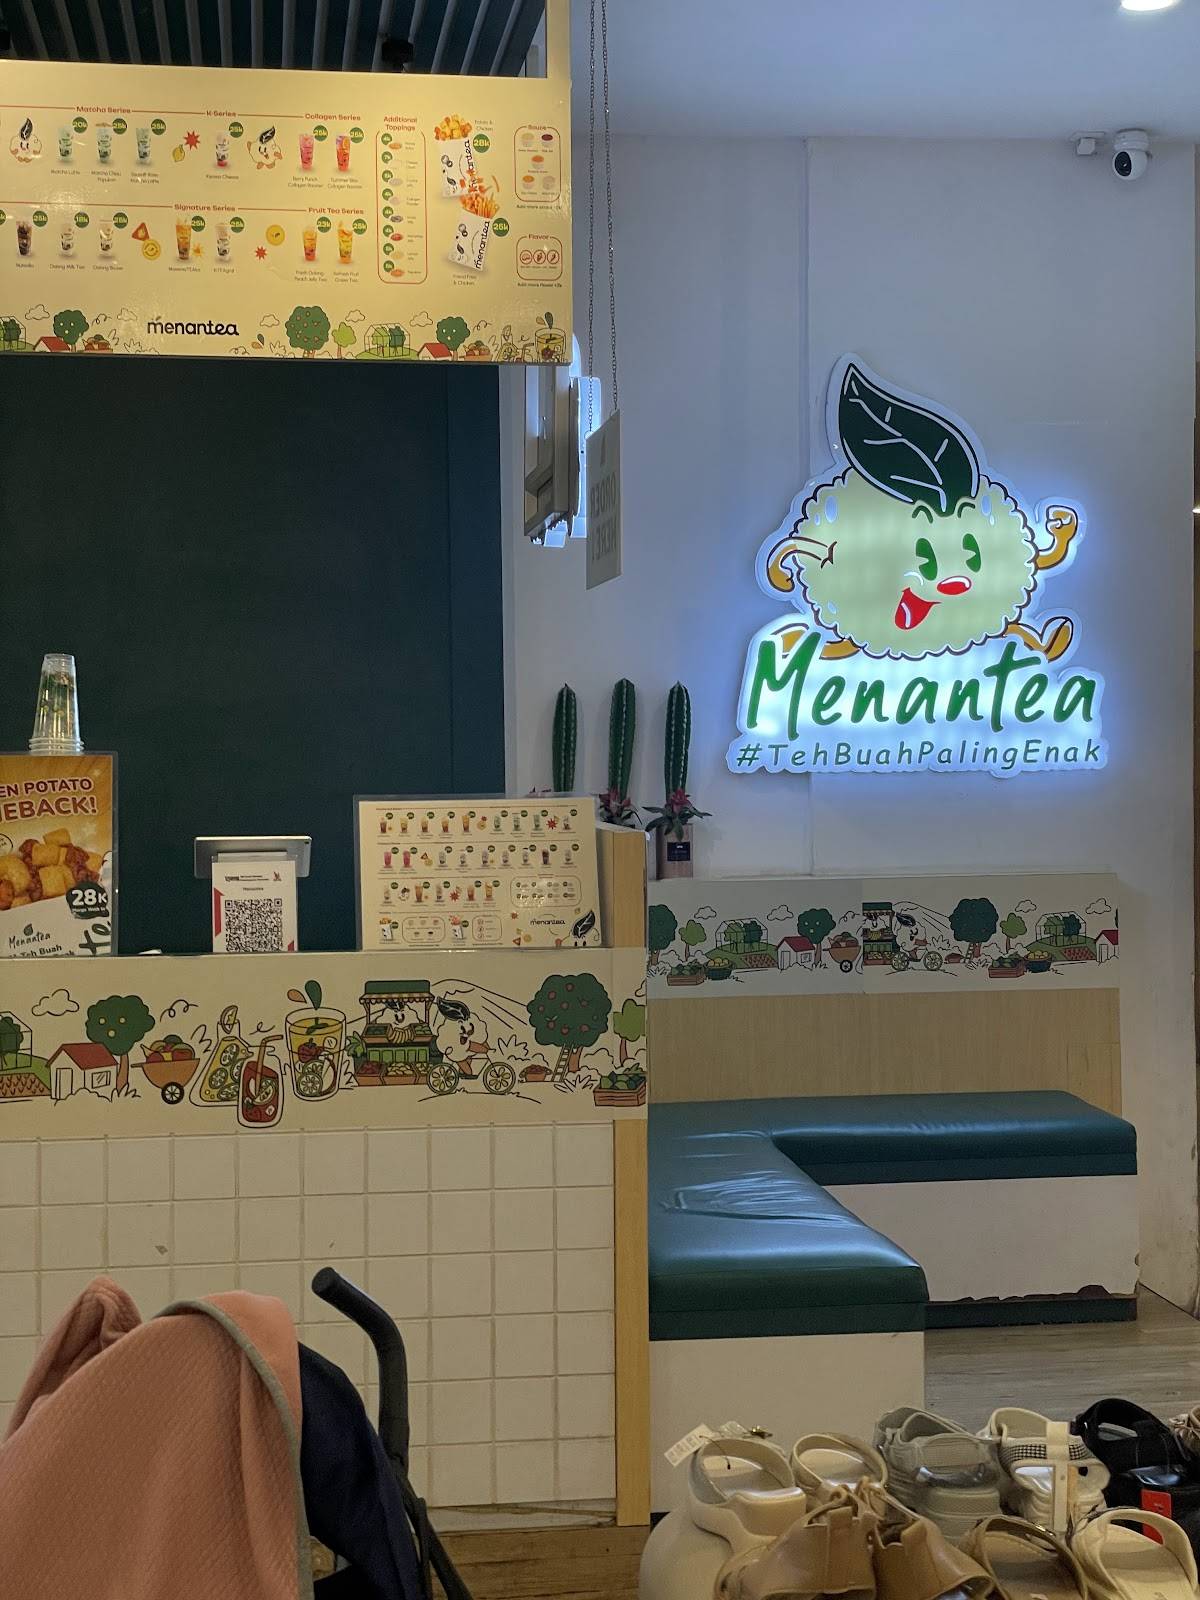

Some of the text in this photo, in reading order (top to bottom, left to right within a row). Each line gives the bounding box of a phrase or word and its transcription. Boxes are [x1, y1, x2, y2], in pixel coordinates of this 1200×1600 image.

[76, 106, 106, 114] Matcha
[304, 113, 337, 121] Collagen
[383, 115, 418, 123] Additional
[385, 124, 416, 132] Toppings
[474, 220, 491, 270] menantea
[147, 318, 239, 336] menantea
[747, 632, 1097, 740] Menantea
[736, 738, 1101, 770] #TehBuahPalingEnak
[24, 778, 92, 794] POTATO
[9, 932, 51, 949] Menantea
[39, 944, 62, 955] Buah
